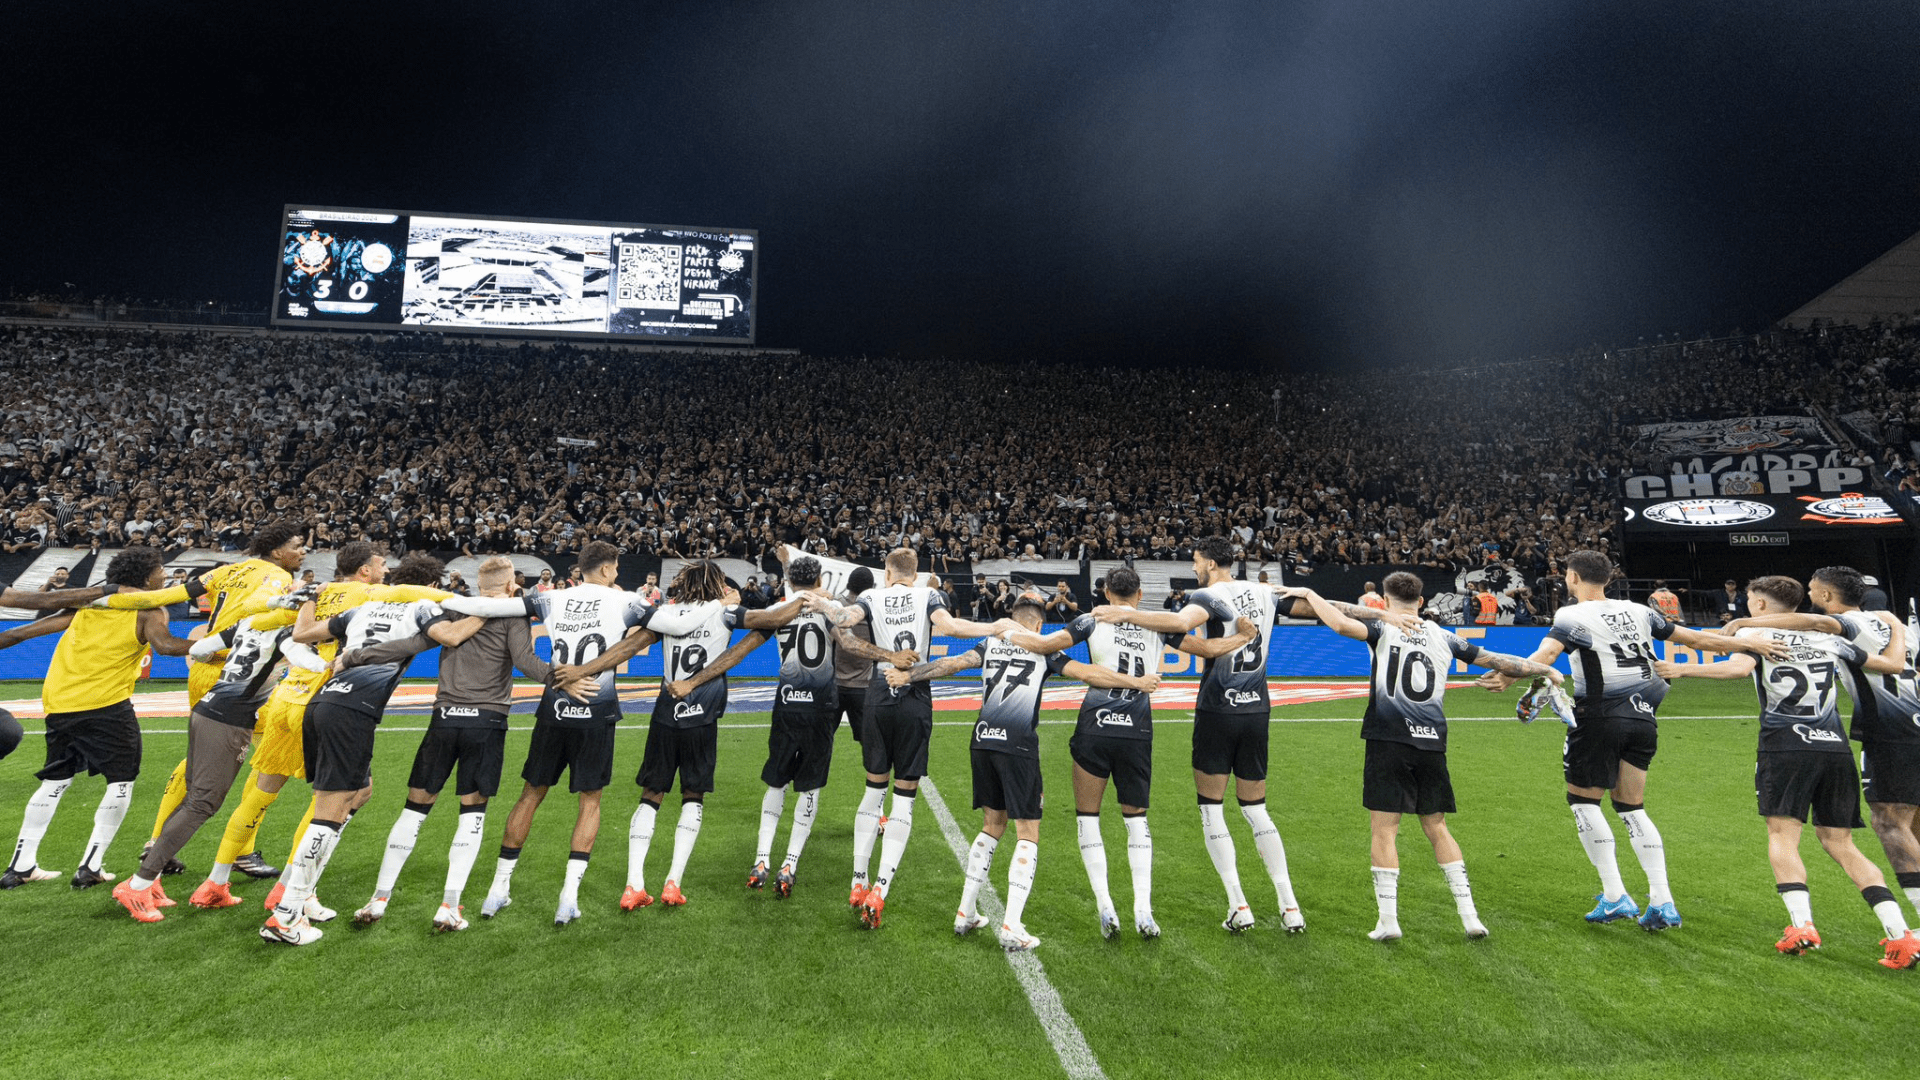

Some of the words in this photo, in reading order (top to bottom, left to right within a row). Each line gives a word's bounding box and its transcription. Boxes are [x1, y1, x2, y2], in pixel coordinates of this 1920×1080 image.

[684, 257, 714, 267] PARTE
[684, 269, 712, 279] DESSA
[313, 279, 333, 299] 3
[348, 281, 368, 300] 0
[1731, 533, 1769, 544] SAÍDA
[565, 598, 601, 613] EZZE
[884, 593, 913, 609] EZZE
[563, 611, 598, 621] SEGUROS
[884, 604, 915, 615] SEGUROS
[554, 622, 580, 633] PEDRO
[777, 622, 826, 669] 70
[671, 644, 708, 681] 19
[1796, 650, 1829, 662] BIDON
[1386, 644, 1436, 703] 10
[984, 658, 1036, 706] 77
[1769, 660, 1835, 716] 27
[785, 690, 814, 702] AREA
[1234, 691, 1261, 704] AREA
[560, 706, 592, 719] AREA
[1101, 713, 1134, 727] AREA
[978, 728, 1008, 741] AREA
[1408, 725, 1439, 739] AREA
[1805, 729, 1843, 743] AREA
[803, 791, 815, 818] ksk
[304, 831, 327, 860] ksk
